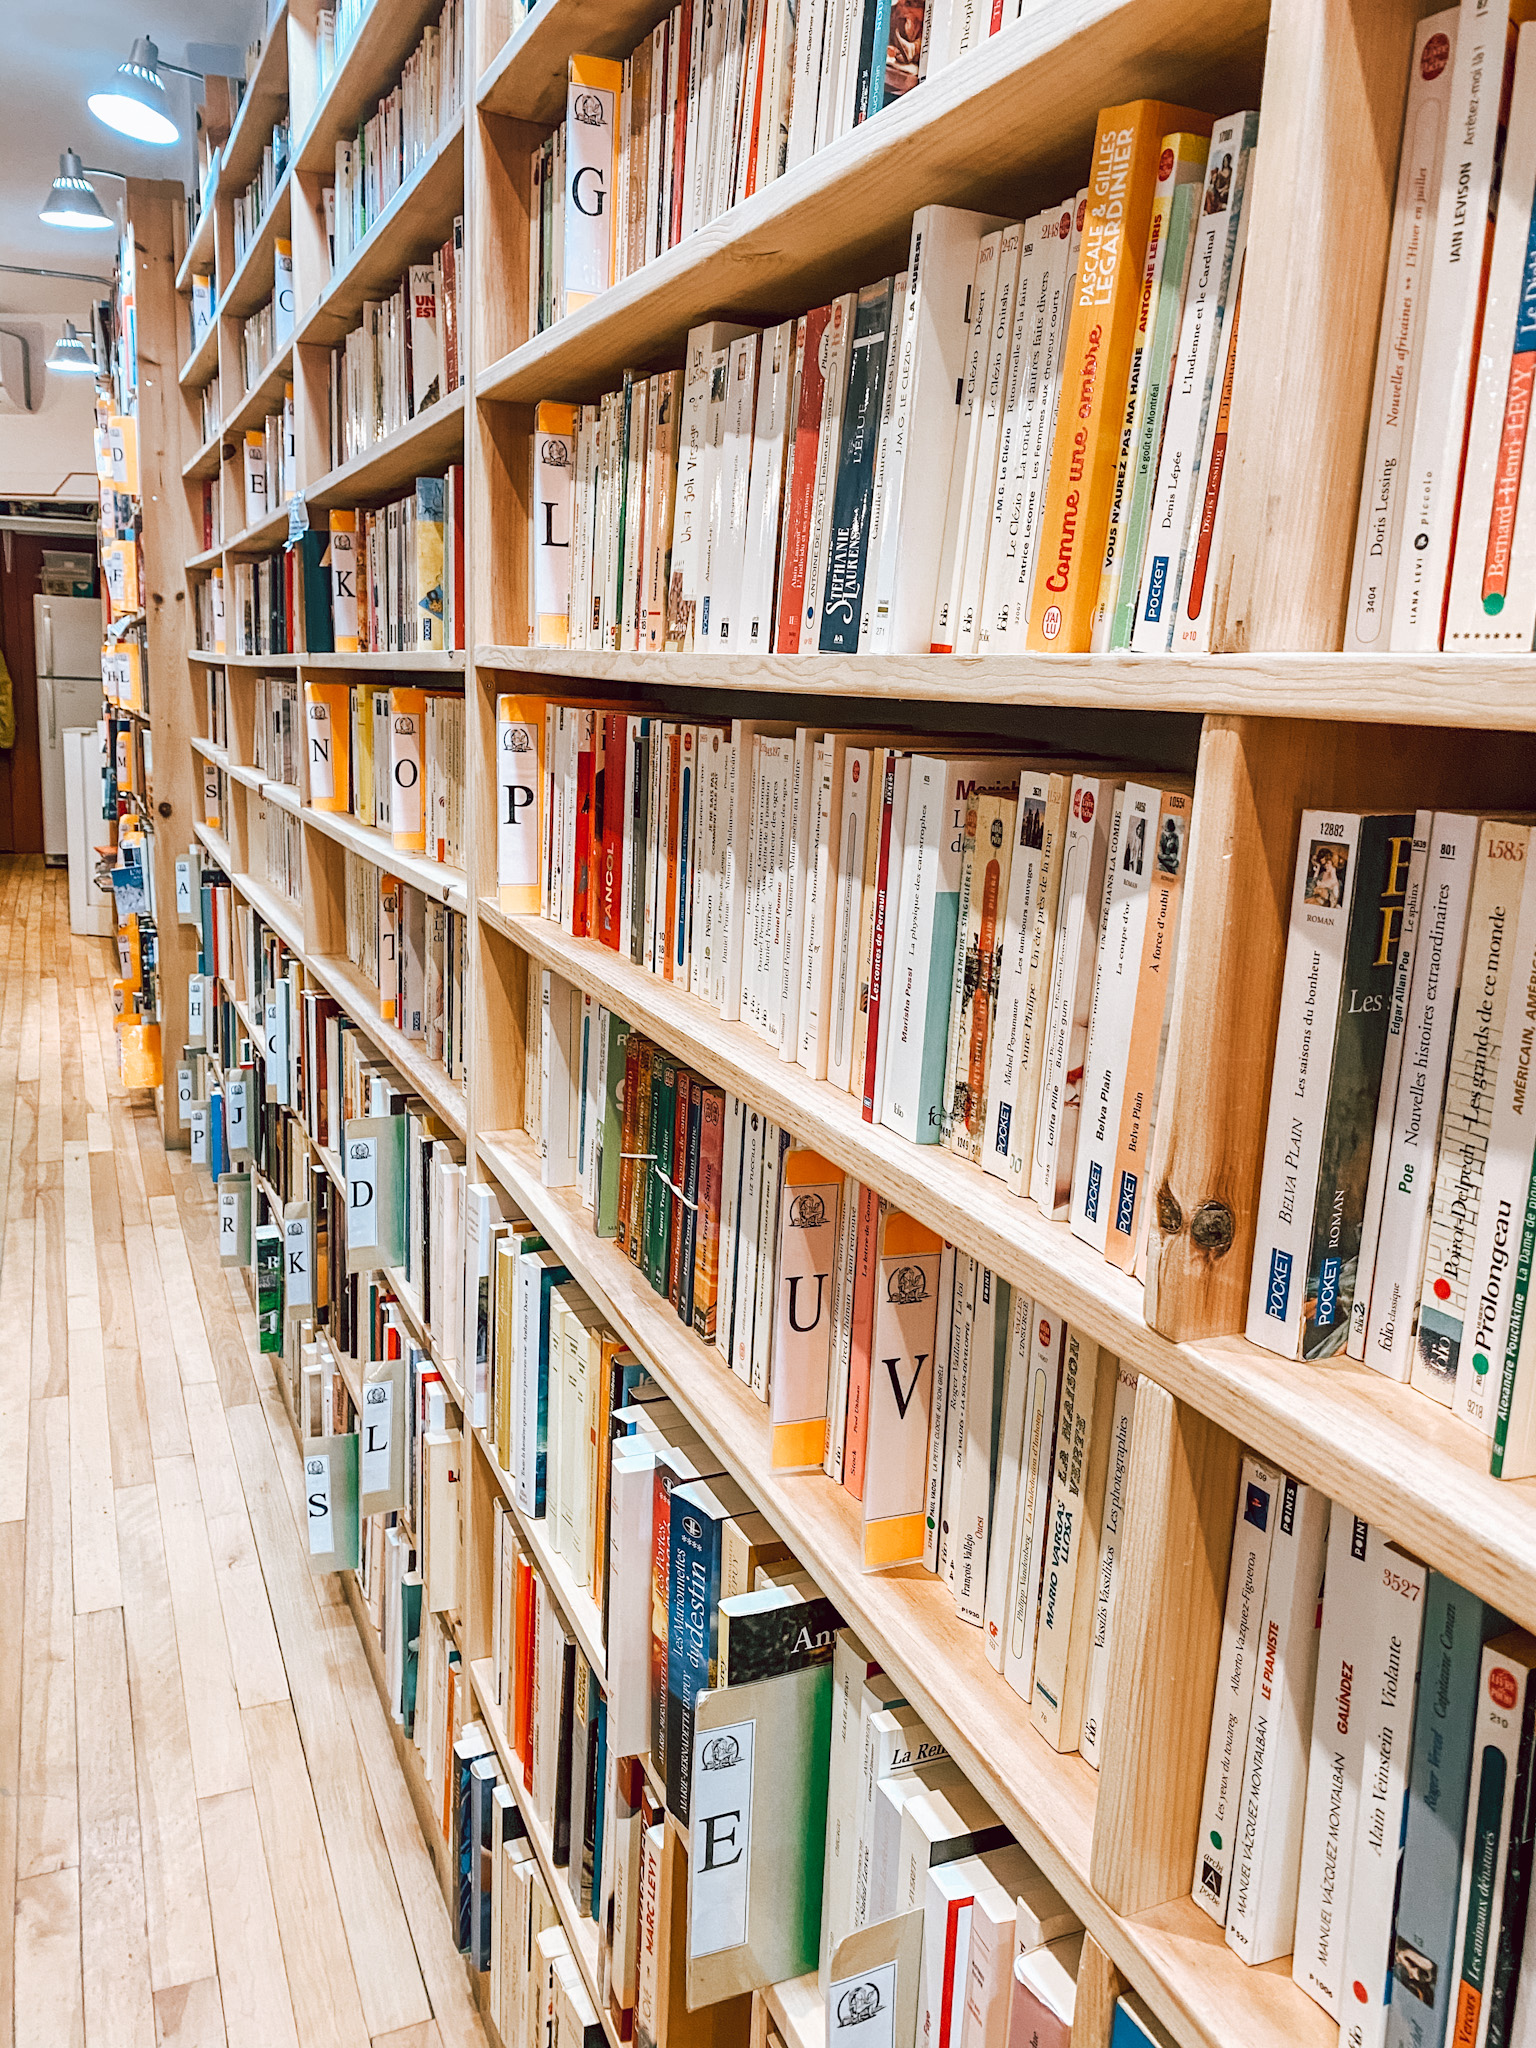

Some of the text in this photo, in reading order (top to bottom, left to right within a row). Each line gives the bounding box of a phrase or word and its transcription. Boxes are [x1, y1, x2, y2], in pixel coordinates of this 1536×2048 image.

[572, 167, 607, 216] G
[1454, 162, 1471, 226] LEVISON
[1080, 131, 1117, 306] PASCALE & GILLES
[1095, 128, 1135, 306] LEGARDINIER
[1197, 231, 1215, 289] Cardinal
[1449, 231, 1463, 263] IAIN
[1193, 307, 1203, 319] et
[1195, 293, 1206, 304] le
[198, 312, 208, 326] A
[1182, 323, 1203, 395] L'Indienne
[1105, 215, 1162, 567] VOUS N'AUREZ PAS MA HAINE ANTOINE LEIRIS
[1046, 324, 1103, 592] Comme une ombre
[1166, 451, 1182, 489] Lépée
[1366, 297, 1412, 613] 3404 Doris Lessing Nouvelles africaines
[1488, 369, 1532, 576] Bernard-Henri LEVY
[252, 475, 266, 494] E
[1421, 471, 1433, 525] piccolo
[541, 502, 568, 547] L
[1162, 494, 1176, 529] Denis
[336, 571, 356, 598] K
[312, 739, 330, 762] N
[205, 785, 217, 798] S
[395, 759, 418, 787] O
[504, 786, 534, 825] P
[915, 805, 928, 870] catastrophes
[1320, 823, 1344, 837] 12882
[1441, 844, 1456, 855] 801
[1487, 840, 1524, 861] 1585
[178, 882, 188, 895] A
[603, 842, 614, 931] PANCOL
[912, 875, 920, 890] des
[1021, 863, 1034, 905] sauvages
[909, 894, 921, 939] physique
[1121, 901, 1131, 923] d'or
[1155, 889, 1170, 928] d'oubli
[1307, 915, 1335, 925] ROMAN
[908, 940, 917, 956] La
[1016, 909, 1029, 955] tambours
[1118, 927, 1129, 959] coupe
[1152, 932, 1163, 959] force
[1487, 906, 1505, 971] monde
[1015, 958, 1023, 974] Les
[1115, 961, 1124, 975] La
[1149, 962, 1160, 973] À
[1304, 951, 1320, 1004] bonheur
[1484, 976, 1496, 996] ce
[191, 1002, 201, 1015] H
[1008, 999, 1020, 1051] Peyramaure
[1302, 1009, 1313, 1025] du
[1478, 1000, 1493, 1022] de
[1004, 1054, 1015, 1085] Michel
[1298, 1031, 1311, 1074] saisons
[1470, 1026, 1491, 1090] grands
[179, 1088, 190, 1101] O
[1100, 1069, 1112, 1102] Plain
[1295, 1078, 1305, 1097] Les
[231, 1105, 243, 1126] J
[1095, 1106, 1108, 1141] Belva
[1132, 1092, 1143, 1118] Plain
[1378, 884, 1449, 1352] folio classique Poe Nouvelles histoires extraordinaires
[1463, 1092, 1480, 1122] Les
[193, 1131, 204, 1143] P
[1128, 1122, 1140, 1152] Belva
[1284, 1118, 1303, 1169] PLAIN
[350, 1181, 373, 1208] D
[1278, 1174, 1298, 1225] BELVA
[223, 1216, 235, 1234] R
[1329, 1190, 1345, 1248] ROMAN
[288, 1249, 306, 1274] K
[1475, 1199, 1511, 1350] Prolongeau
[785, 1273, 828, 1332] U
[1428, 1336, 1451, 1373] folio
[882, 1354, 929, 1419] V
[1061, 1334, 1080, 1440] MAISON
[365, 1425, 387, 1454] L
[1069, 1413, 1086, 1497] VERTE
[308, 1494, 329, 1518] S
[1061, 1512, 1073, 1563] LLOSA
[1045, 1500, 1065, 1629] MARIO VARGAS
[1085, 1416, 1129, 1747] folio Vassilis Vassilikos Les photographies
[671, 1548, 687, 1656] Les Marionnettes
[1383, 1568, 1420, 1600] 3527
[682, 1560, 707, 1668] du destin
[1214, 1551, 1257, 1822] Les yeux du touareg Alberto Vazquez-Figueroa
[1237, 1488, 1295, 1918] MANUEL VÁZQUEZ MONTALBÁN LE PIANISTE POINTS
[679, 1670, 693, 1810] MARIE-BERNADETTE DUPUY
[893, 1748, 911, 1766] La
[1318, 1518, 1365, 1966] MANUEL VÁZQUEZ MONTALBÁN GALÍNDEZ POINT
[1368, 1636, 1402, 1856] Alain Veinstein Violante
[698, 1810, 742, 1874] E
[644, 1852, 657, 1954] MARC LEVY
[1461, 1831, 1495, 2044] Vercors Les animaux dénaturés
